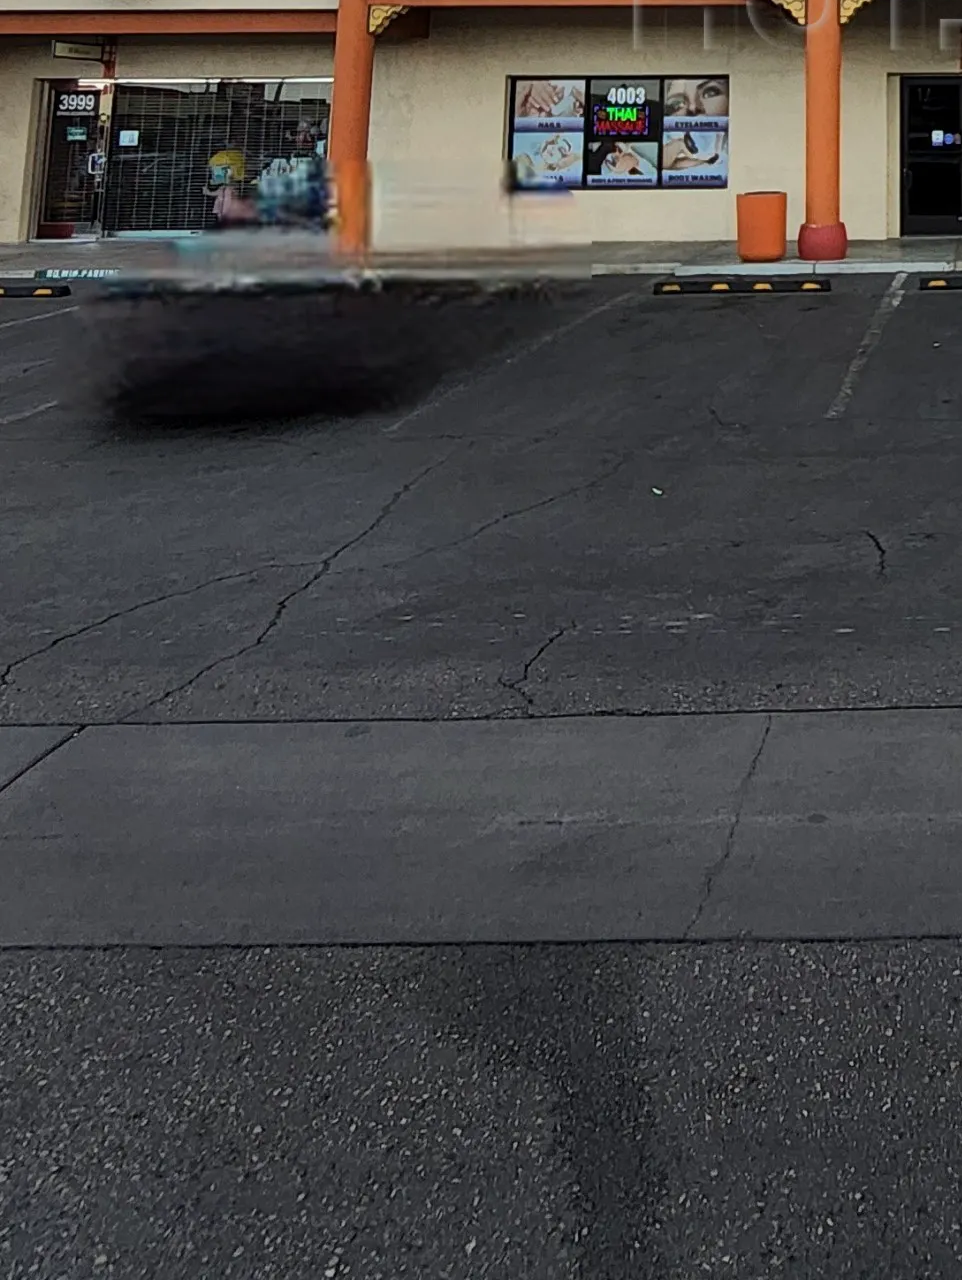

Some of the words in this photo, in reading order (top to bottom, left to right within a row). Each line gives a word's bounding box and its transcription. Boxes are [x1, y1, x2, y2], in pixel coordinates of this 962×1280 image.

[59, 94, 95, 110] 3999
[607, 87, 646, 104] 4003
[607, 107, 637, 121] THAI
